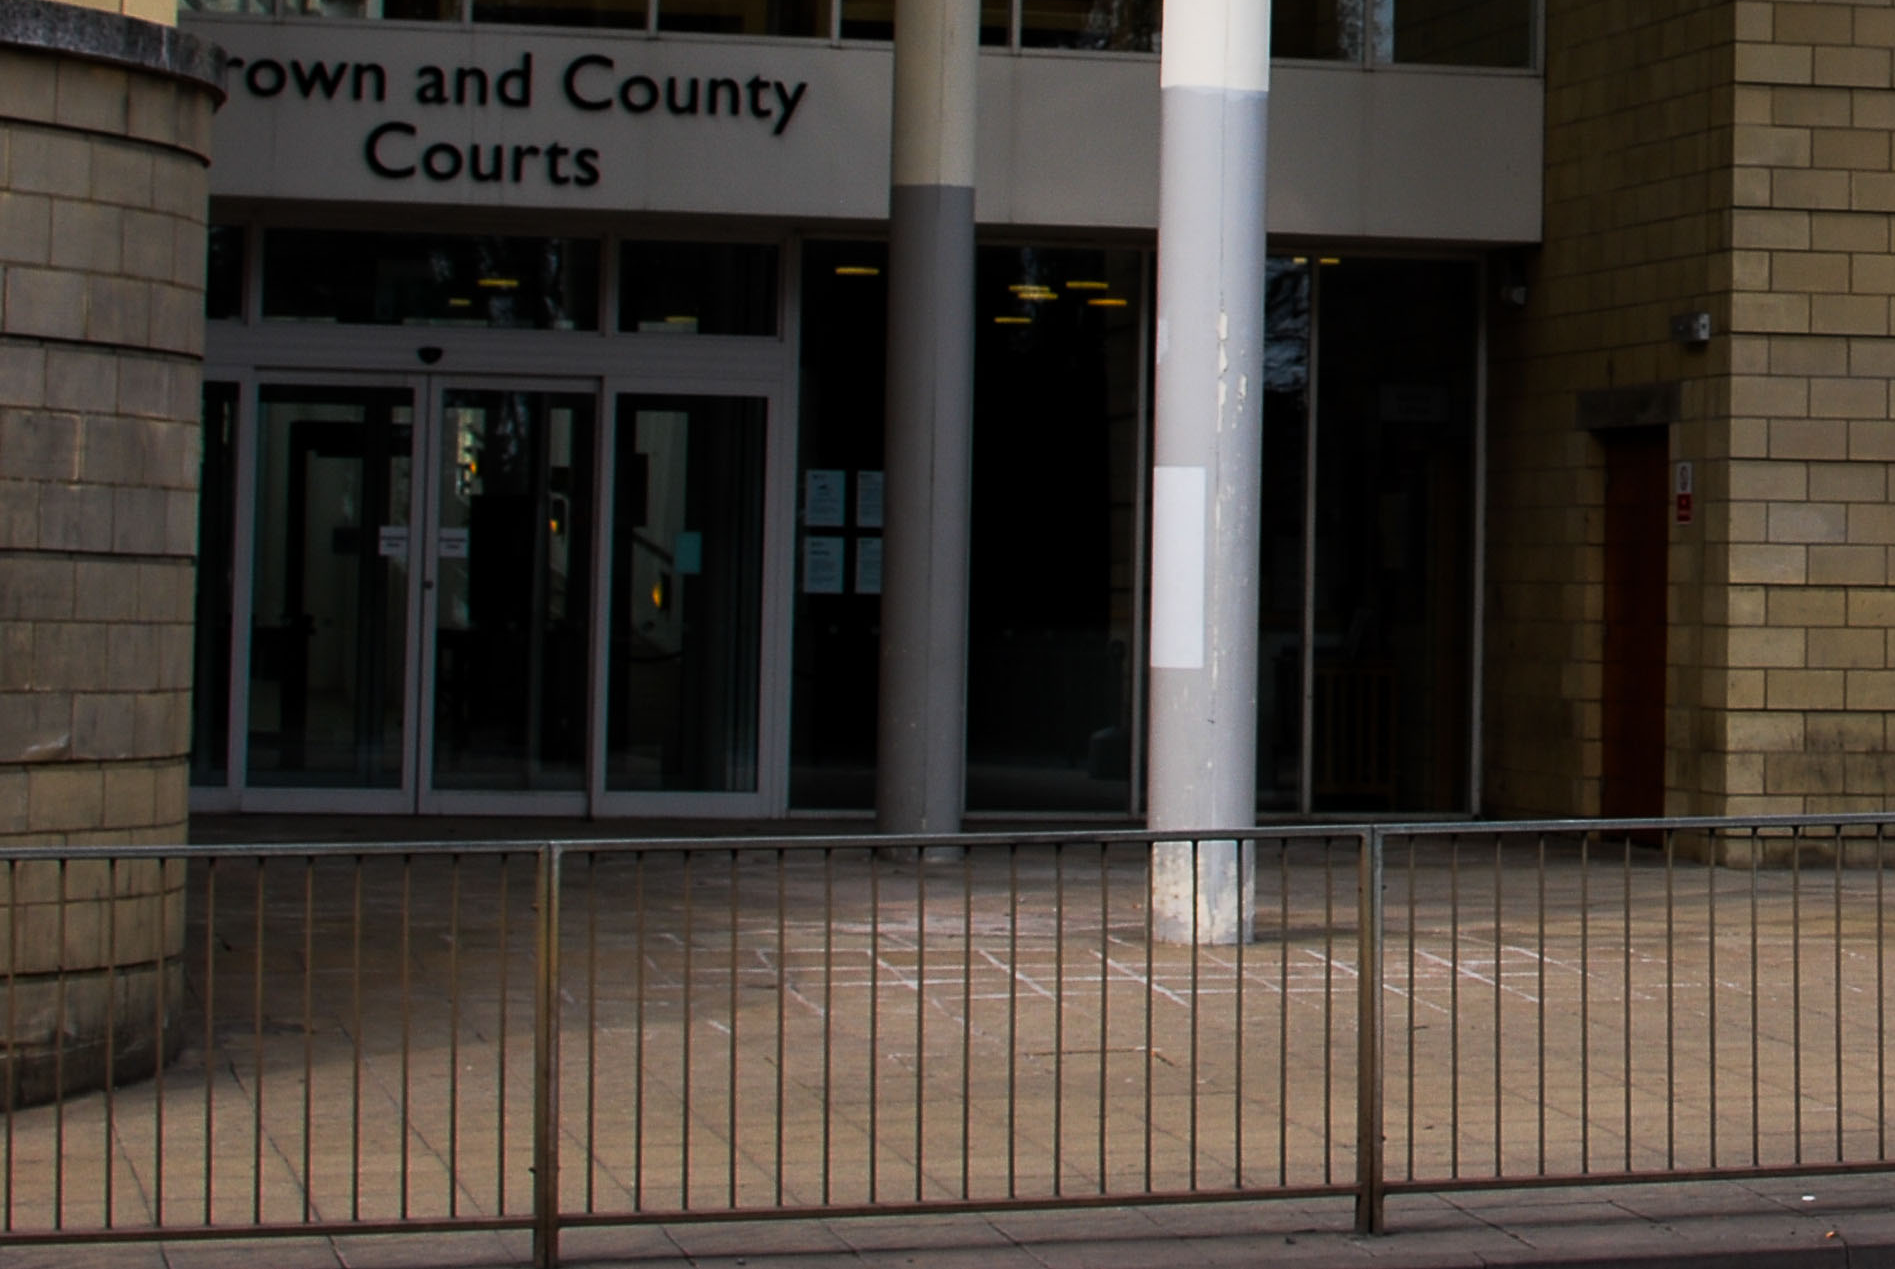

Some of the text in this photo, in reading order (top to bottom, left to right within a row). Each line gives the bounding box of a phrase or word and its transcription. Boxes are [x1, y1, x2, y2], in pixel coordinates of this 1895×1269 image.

[226, 51, 808, 137] own and County
[363, 121, 600, 188] Courts
